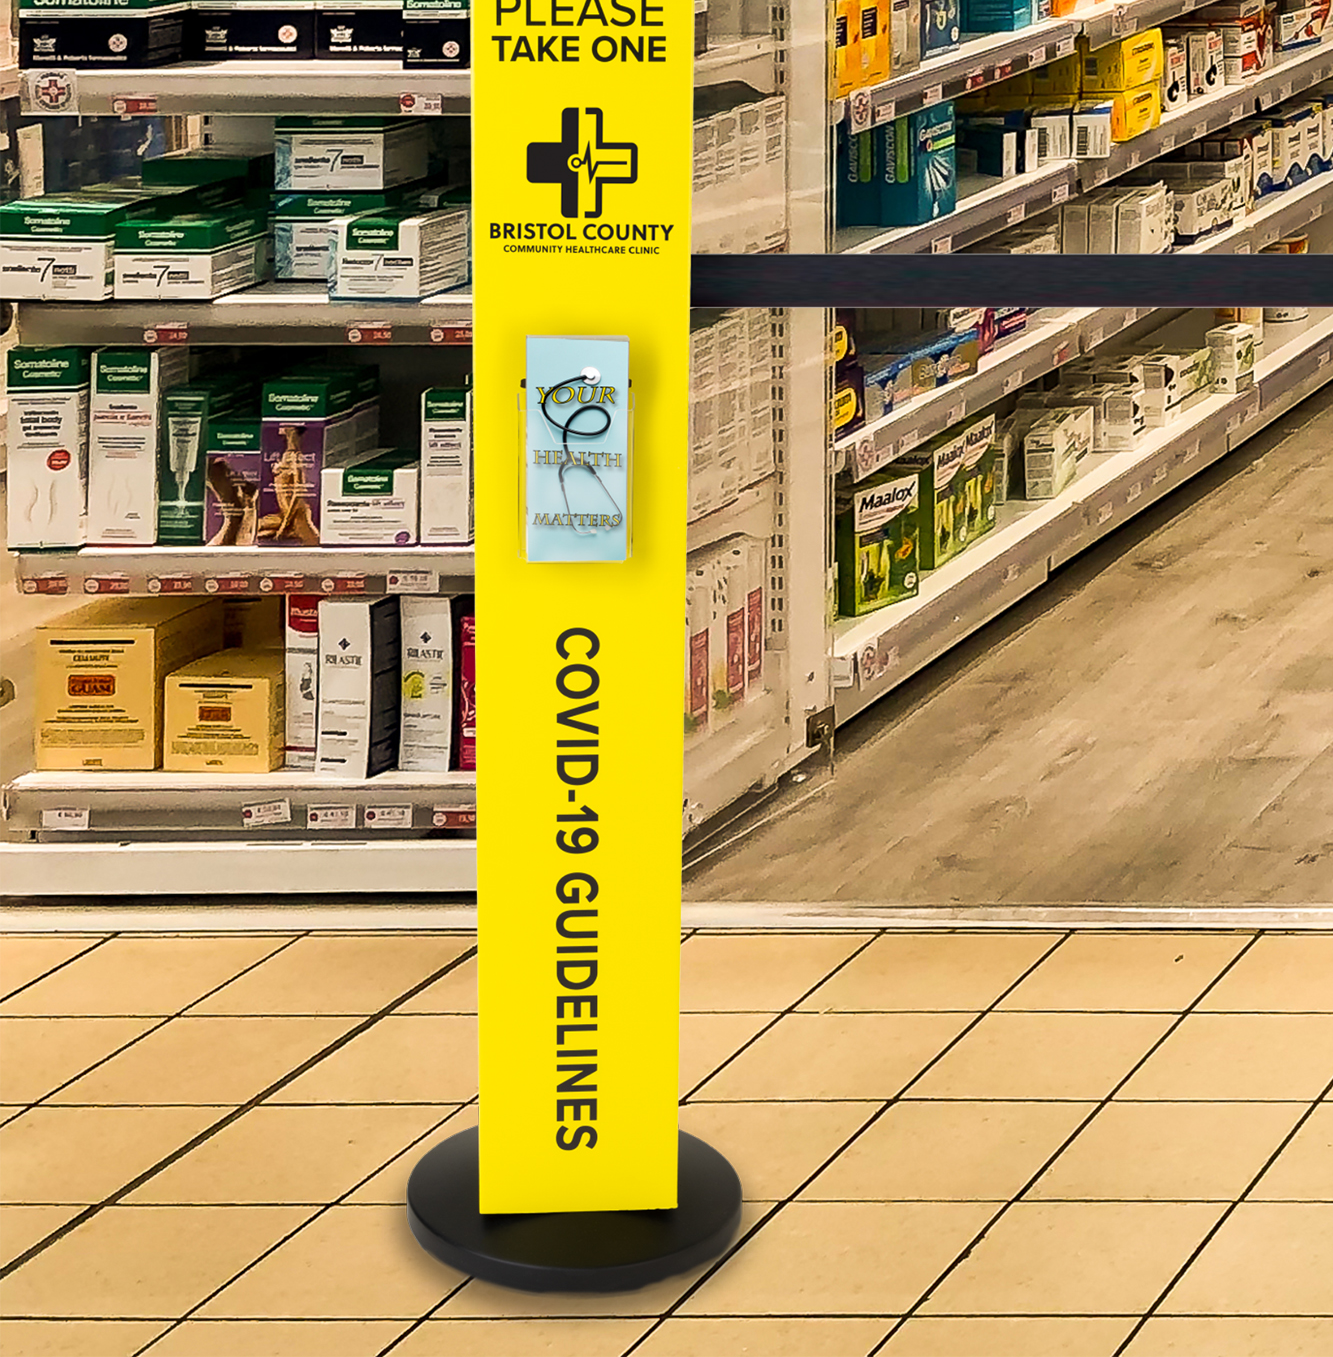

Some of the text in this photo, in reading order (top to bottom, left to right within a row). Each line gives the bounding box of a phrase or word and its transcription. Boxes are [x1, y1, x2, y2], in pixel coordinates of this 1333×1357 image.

[406, 0, 462, 9] Somatoline
[491, 35, 667, 63] TAKE ONE
[489, 222, 675, 242] BRISTOL COUNTY
[503, 245, 660, 255] COMMUNITY HEALTHCARE CLINIC
[536, 386, 616, 406] YOUR
[965, 421, 996, 448] Maalox
[532, 449, 622, 468] HEALTH
[936, 443, 965, 470] Maalox
[858, 475, 917, 513] Maalox
[531, 511, 621, 527] MATTERS
[555, 627, 600, 854] COVID-19
[555, 871, 599, 1152] GUIDELINES
